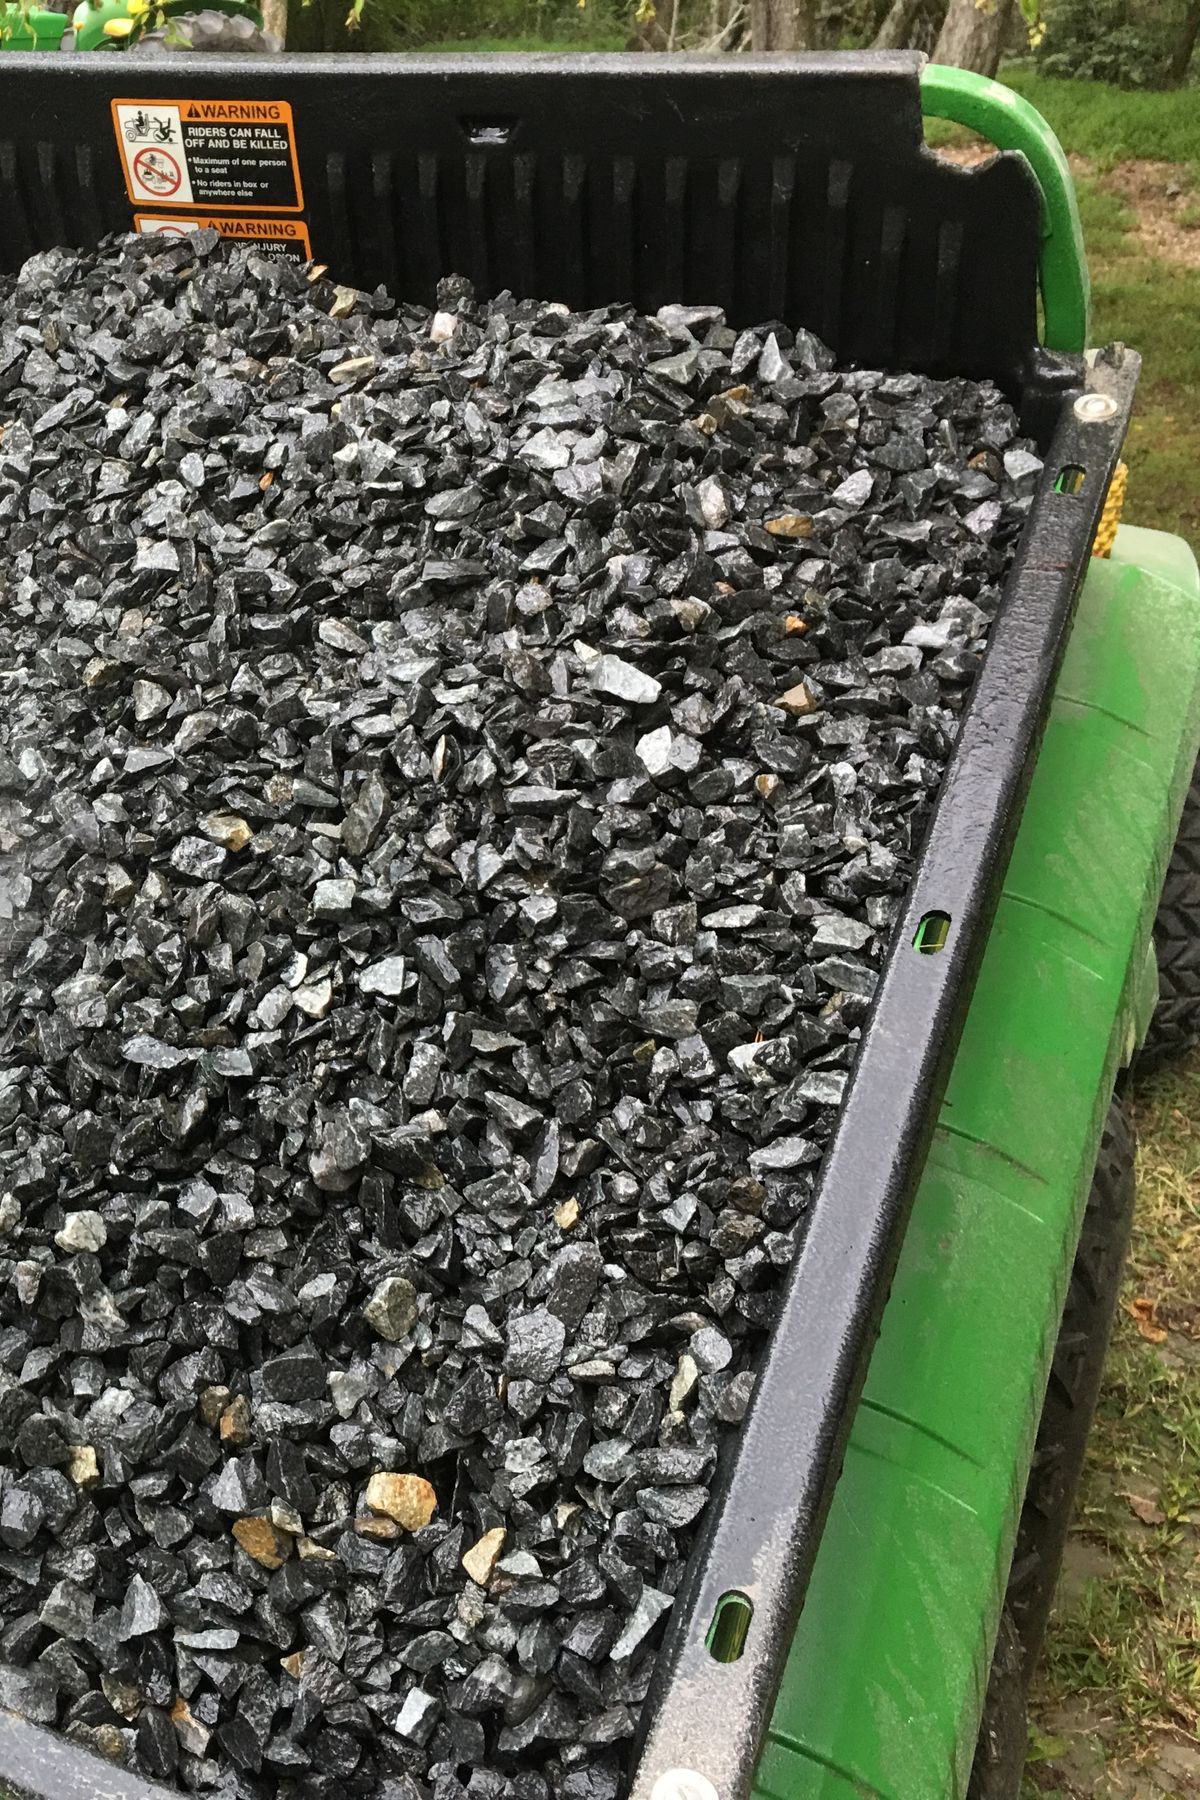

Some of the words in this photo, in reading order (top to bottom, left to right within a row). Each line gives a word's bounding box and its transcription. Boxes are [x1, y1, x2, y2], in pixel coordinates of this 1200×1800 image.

[201, 104, 280, 119] WARNING
[188, 127, 227, 137] RIDERS
[229, 127, 251, 138] CAN
[254, 128, 281, 138] FALL
[185, 138, 205, 148] OFF
[208, 139, 230, 149] AND
[233, 140, 247, 149] BE
[250, 140, 288, 150] KILLED
[192, 157, 230, 165] Maximum
[231, 158, 240, 166] of
[259, 159, 287, 168] person
[195, 166, 203, 174] to
[196, 179, 208, 187] No
[209, 179, 232, 188] riders
[243, 180, 258, 188] box
[198, 189, 235, 197] anywhere
[237, 189, 254, 197] else
[220, 222, 297, 236] WARNING
